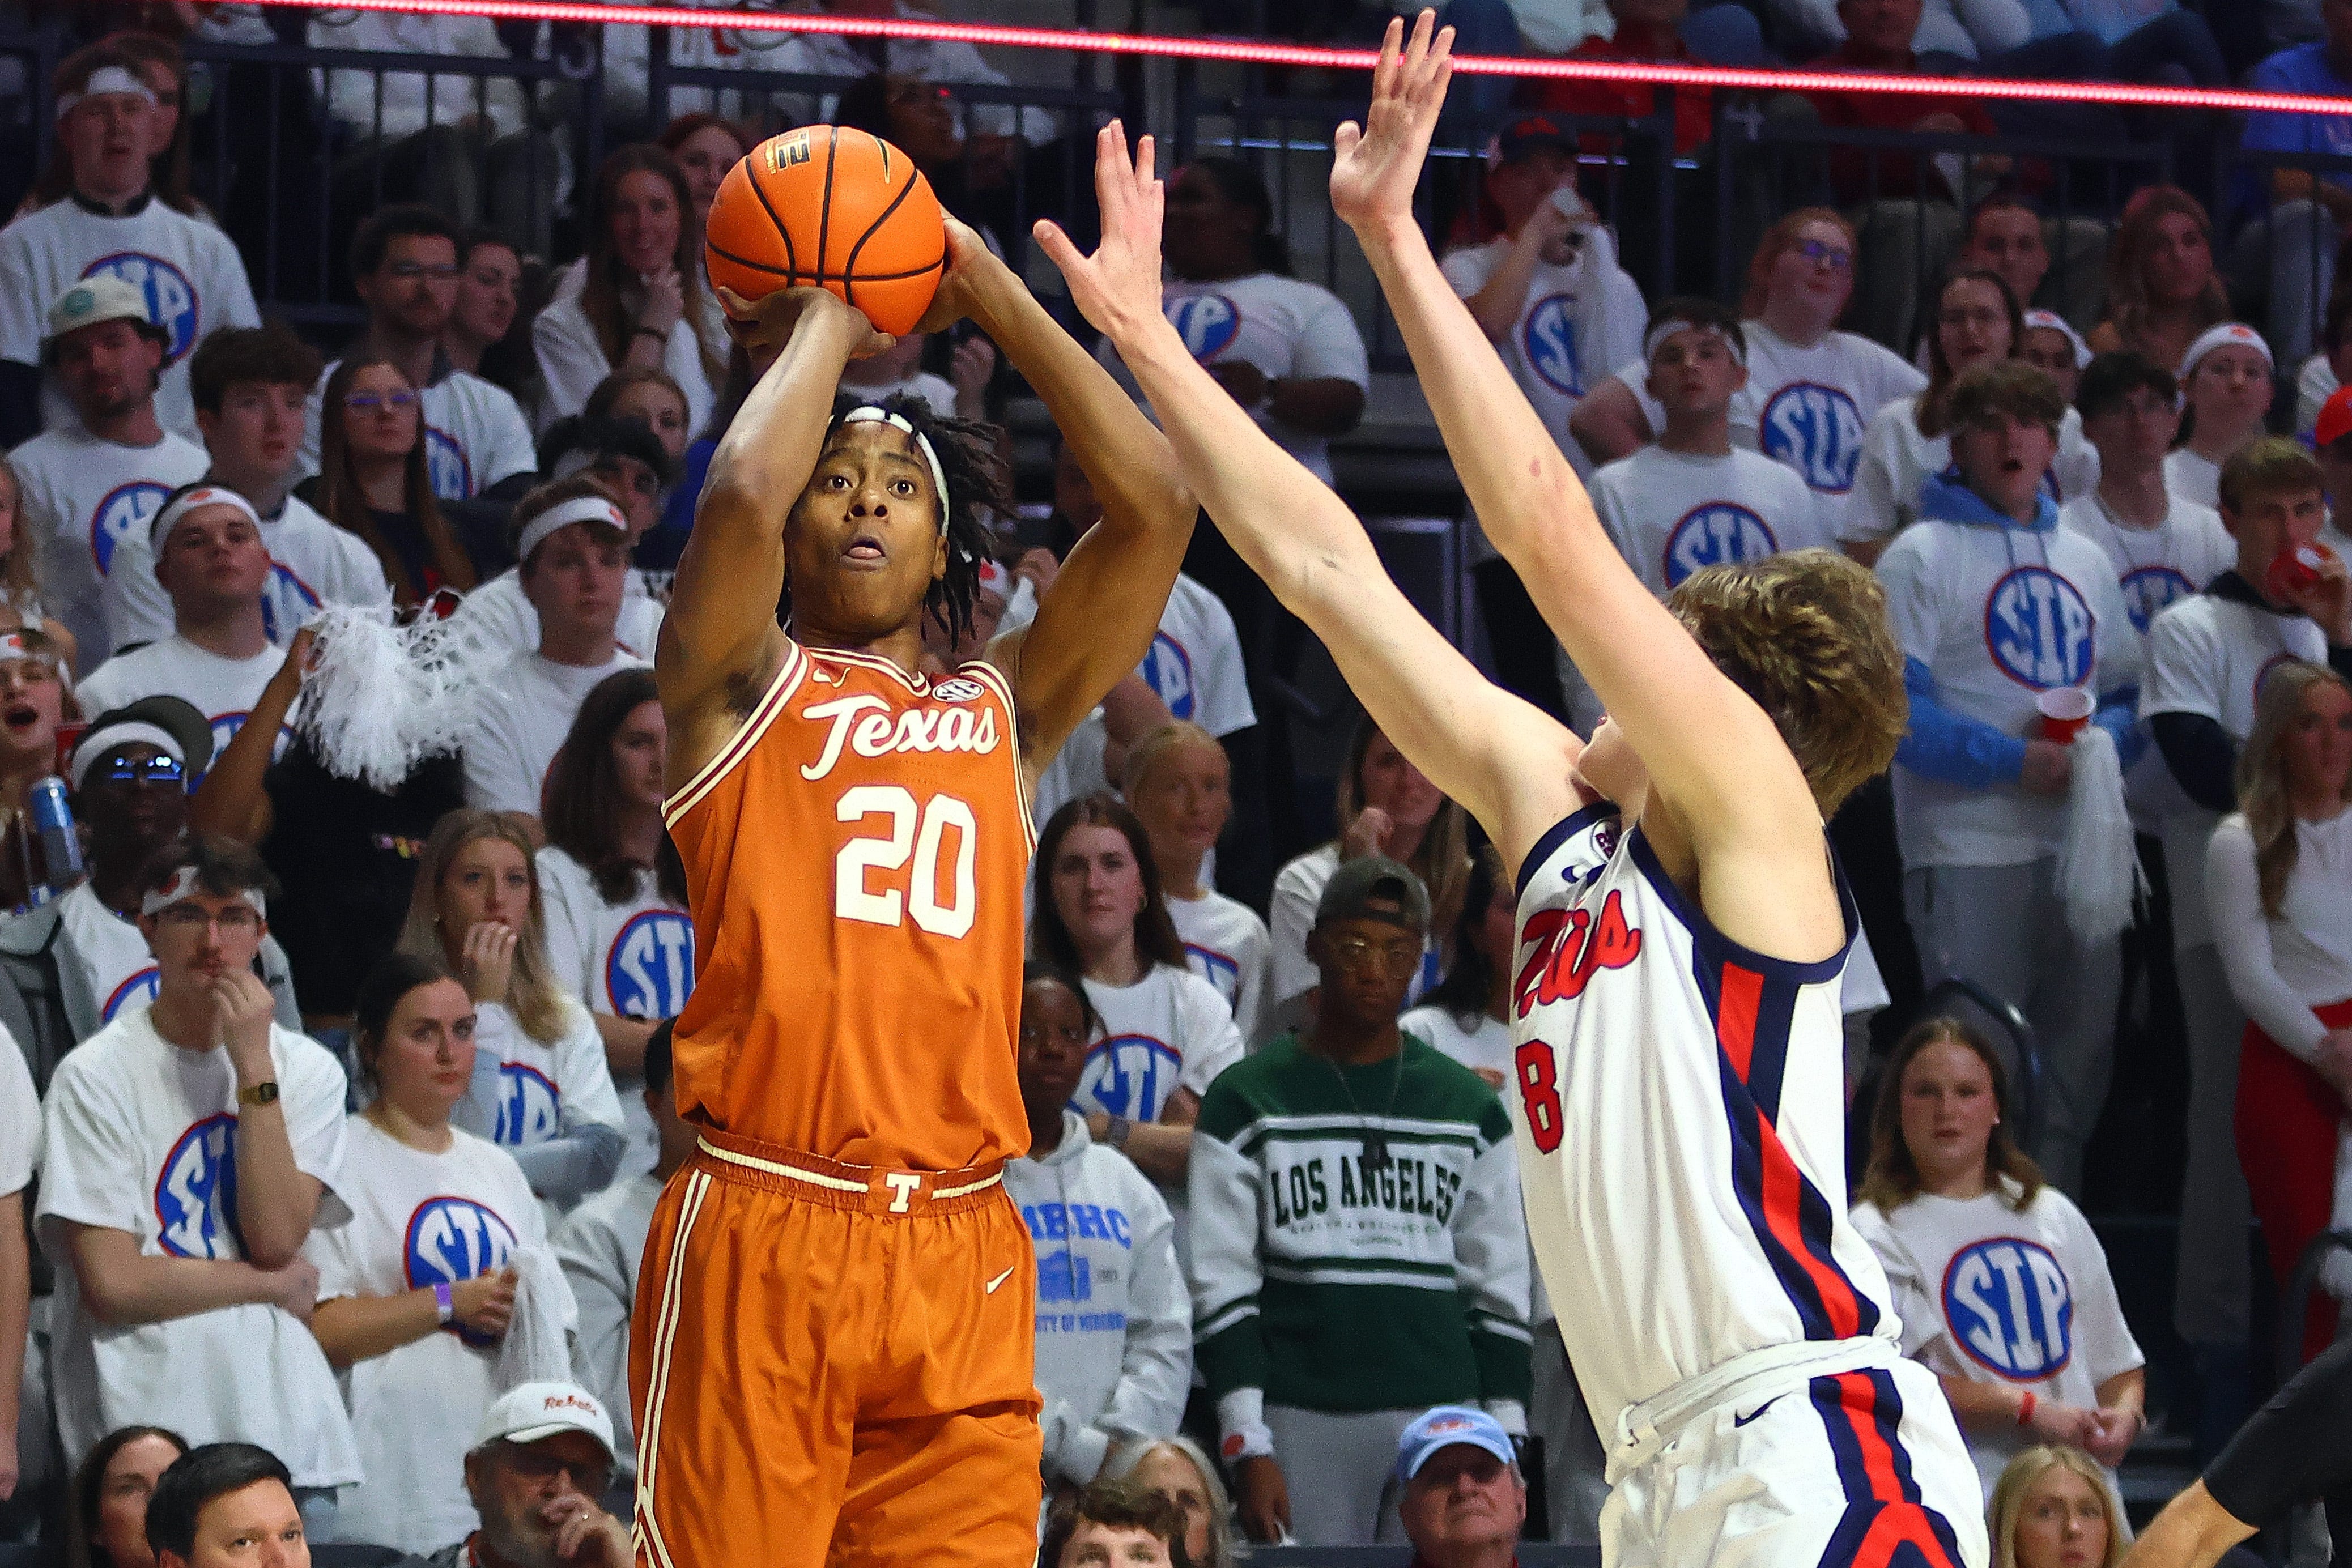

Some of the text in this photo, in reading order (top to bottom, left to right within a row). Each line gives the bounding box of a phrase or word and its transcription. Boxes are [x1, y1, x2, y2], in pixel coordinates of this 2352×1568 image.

[1771, 391, 1864, 486] SIP
[1997, 576, 2090, 681] SIP
[799, 694, 1000, 781] Texas
[836, 785, 976, 939] 20
[619, 919, 696, 1018] SI
[1515, 1038, 1564, 1154] 8
[885, 1172, 922, 1213] T
[1271, 1157, 1329, 1228] LOS
[1954, 1245, 2068, 1371] SIP
